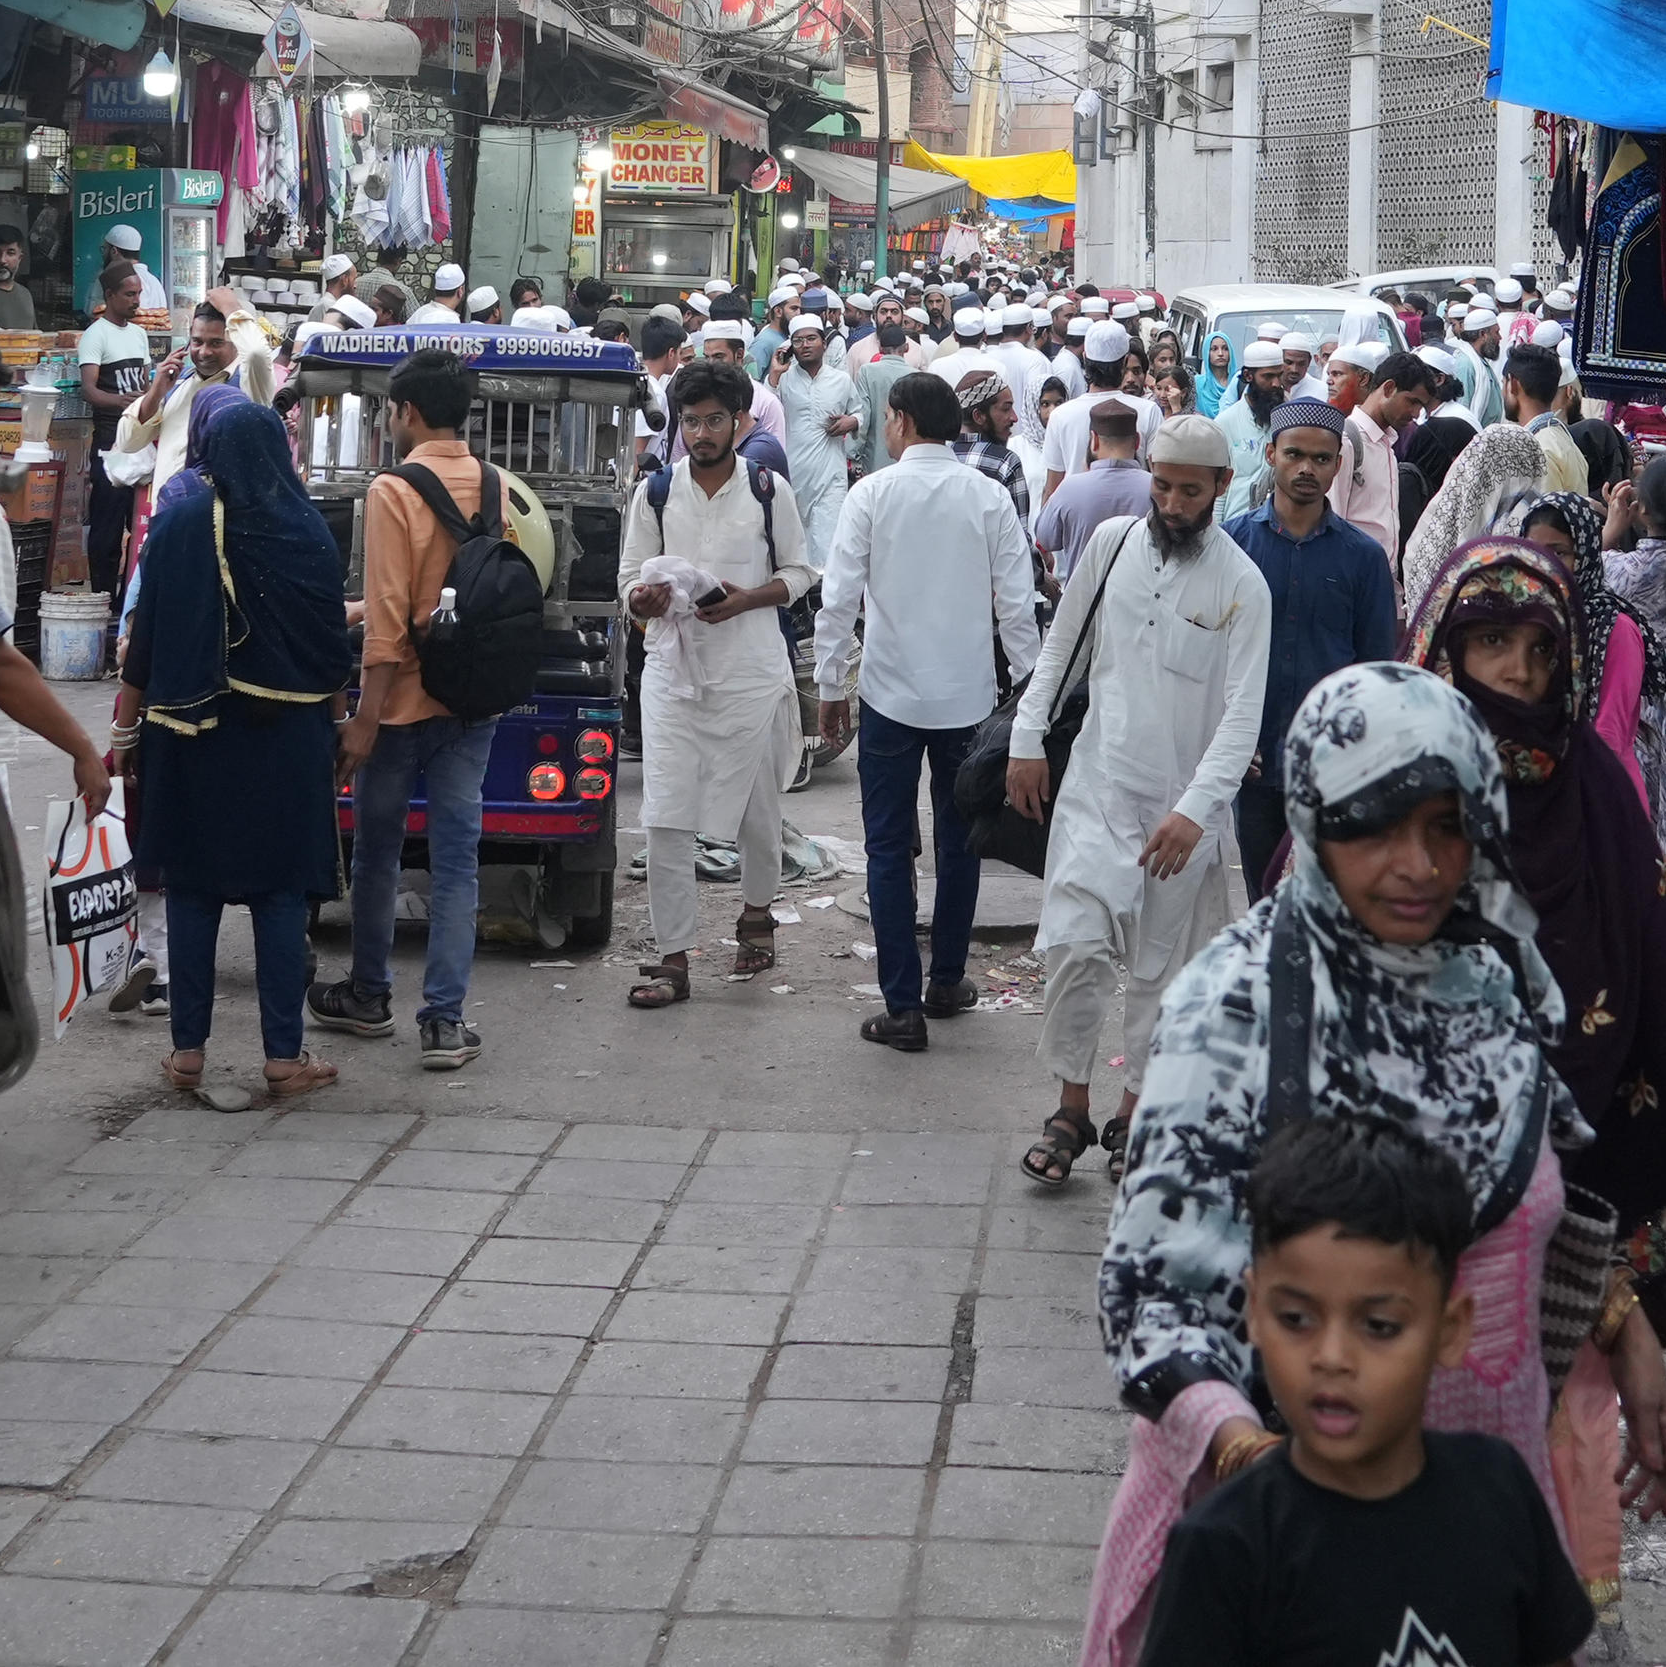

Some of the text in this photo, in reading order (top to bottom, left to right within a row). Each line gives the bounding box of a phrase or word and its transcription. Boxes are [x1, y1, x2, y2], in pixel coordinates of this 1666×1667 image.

[92, 108, 171, 119] TOOTH POWDE
[612, 143, 706, 163] MONEY
[611, 164, 705, 184] CHANGER
[182, 175, 217, 200] Bisleri
[78, 183, 154, 219] Bisleri
[321, 335, 605, 359] WADHERA MOTORS 9999060557
[68, 879, 123, 923] EXPORT
